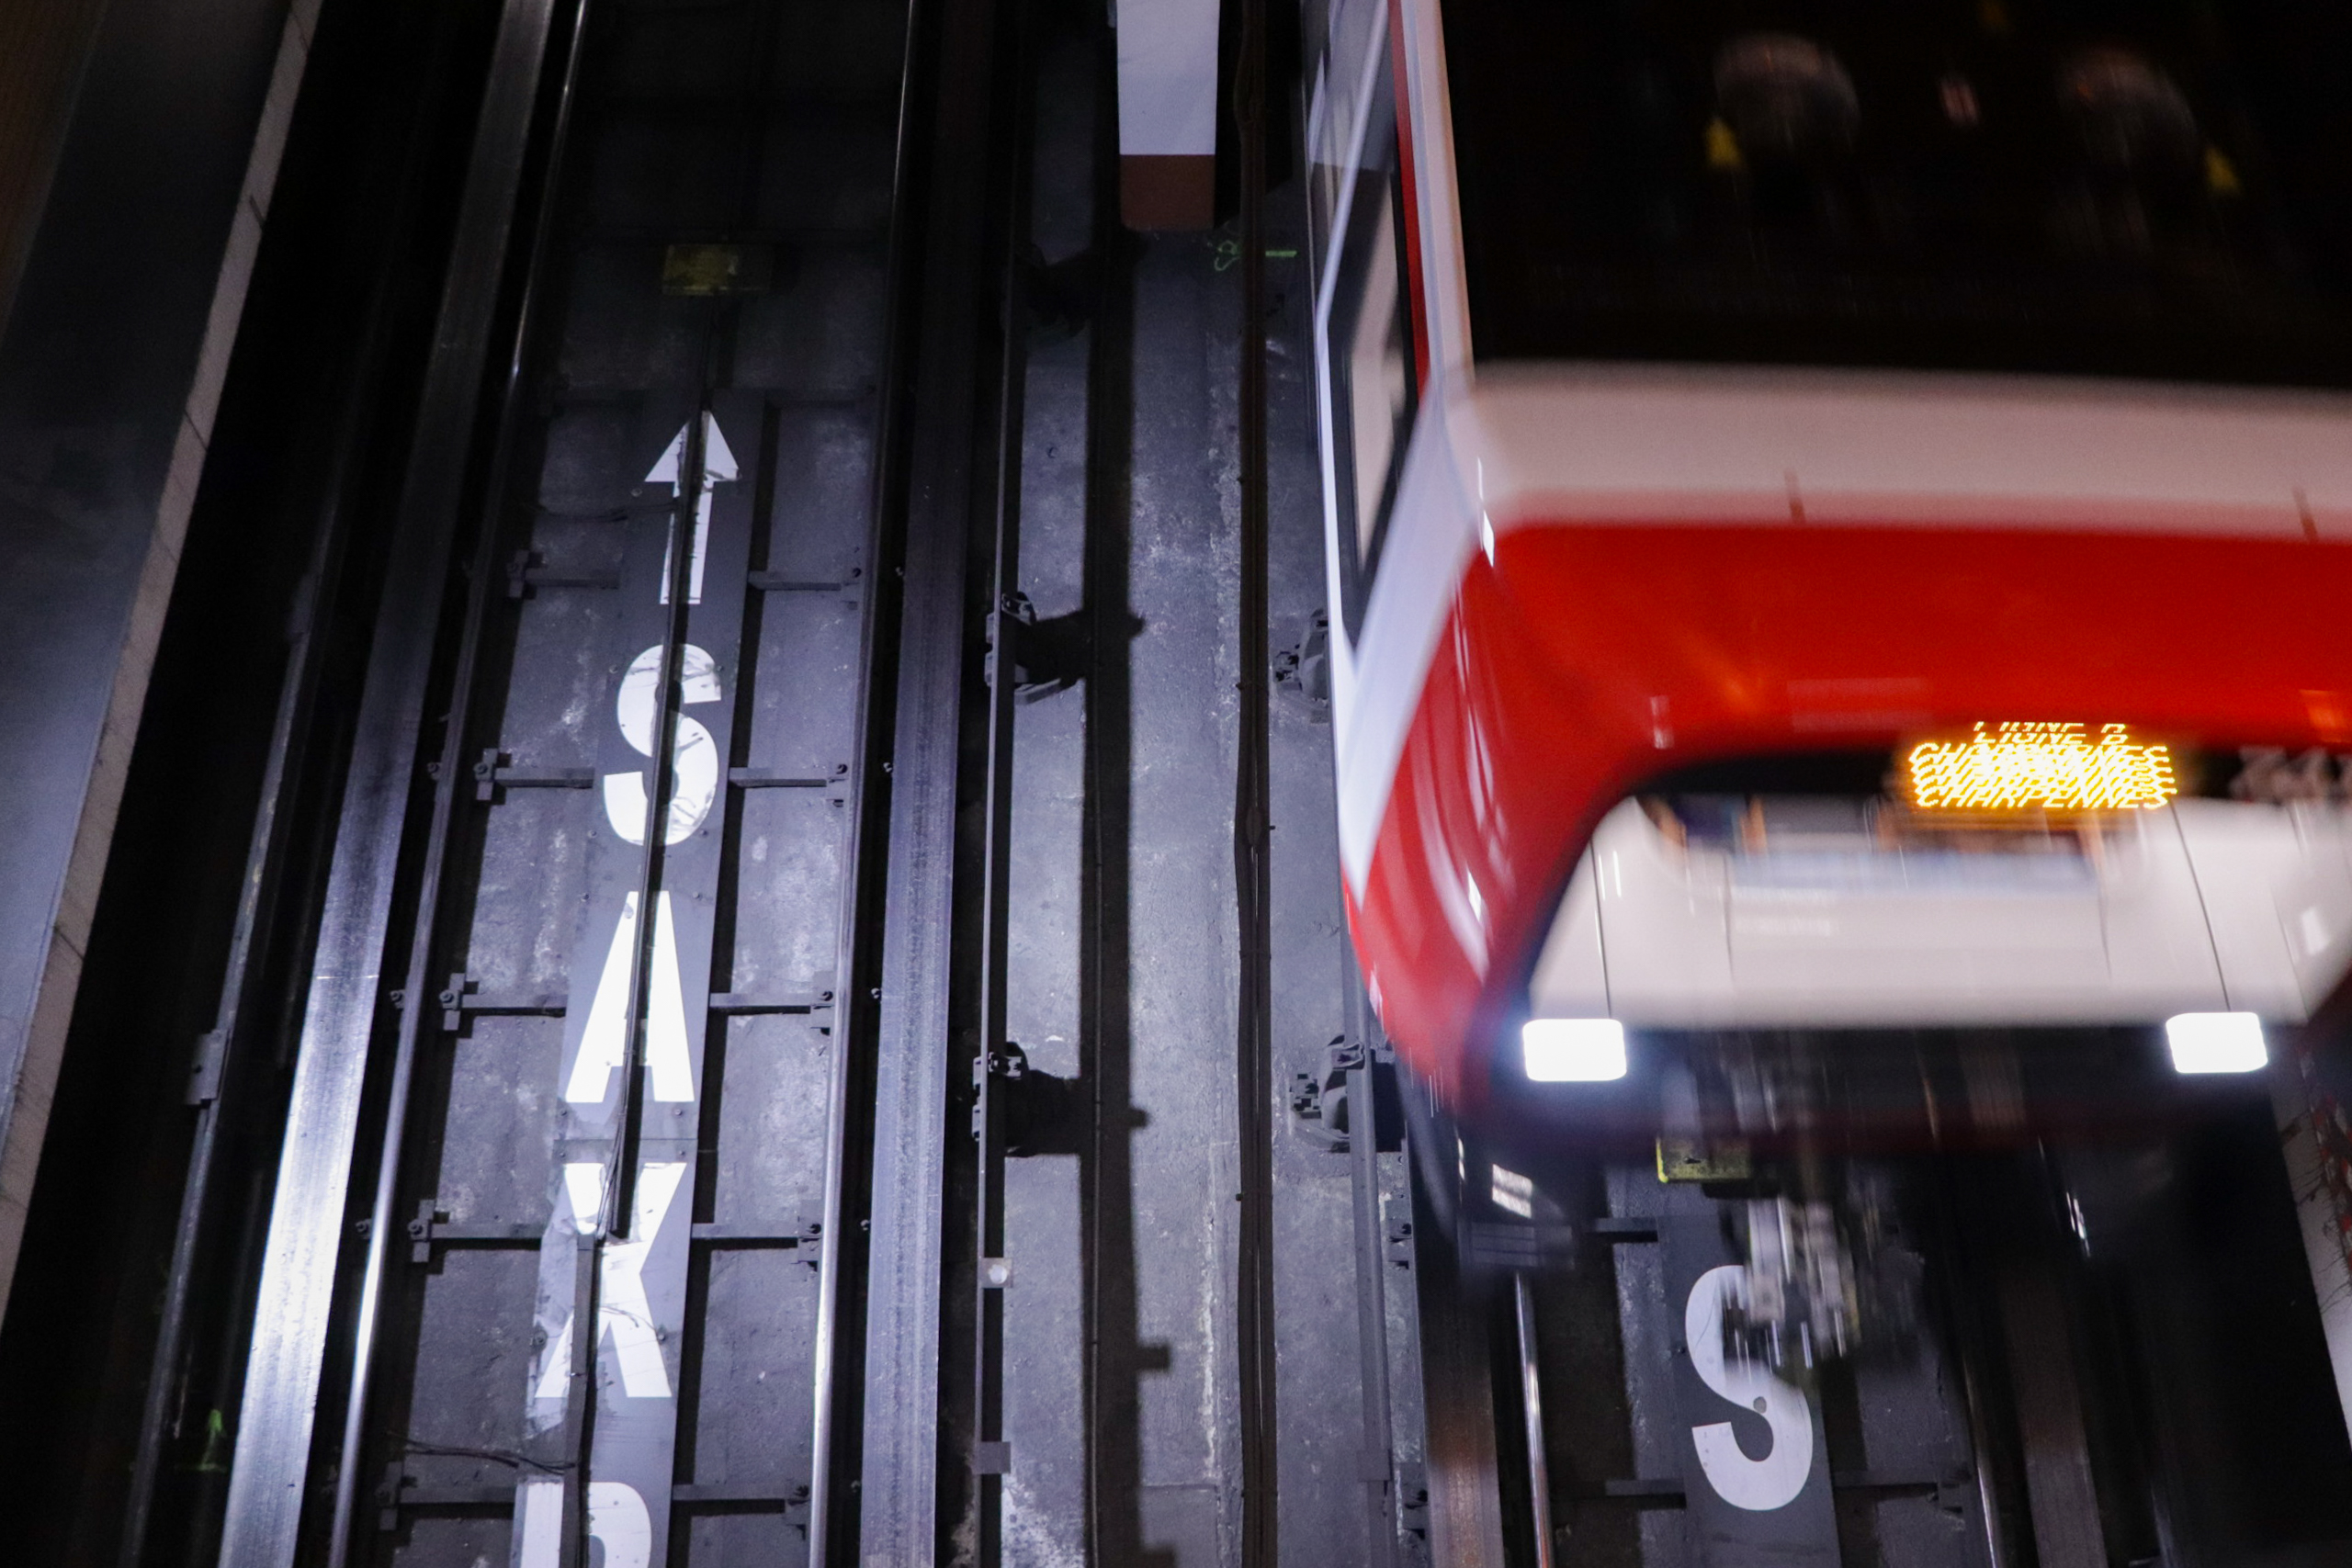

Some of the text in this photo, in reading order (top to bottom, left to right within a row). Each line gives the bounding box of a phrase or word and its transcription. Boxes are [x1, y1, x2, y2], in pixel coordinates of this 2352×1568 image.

[1973, 721, 2129, 746] LIGNE B
[1910, 742, 2177, 809] CHARPENNES
